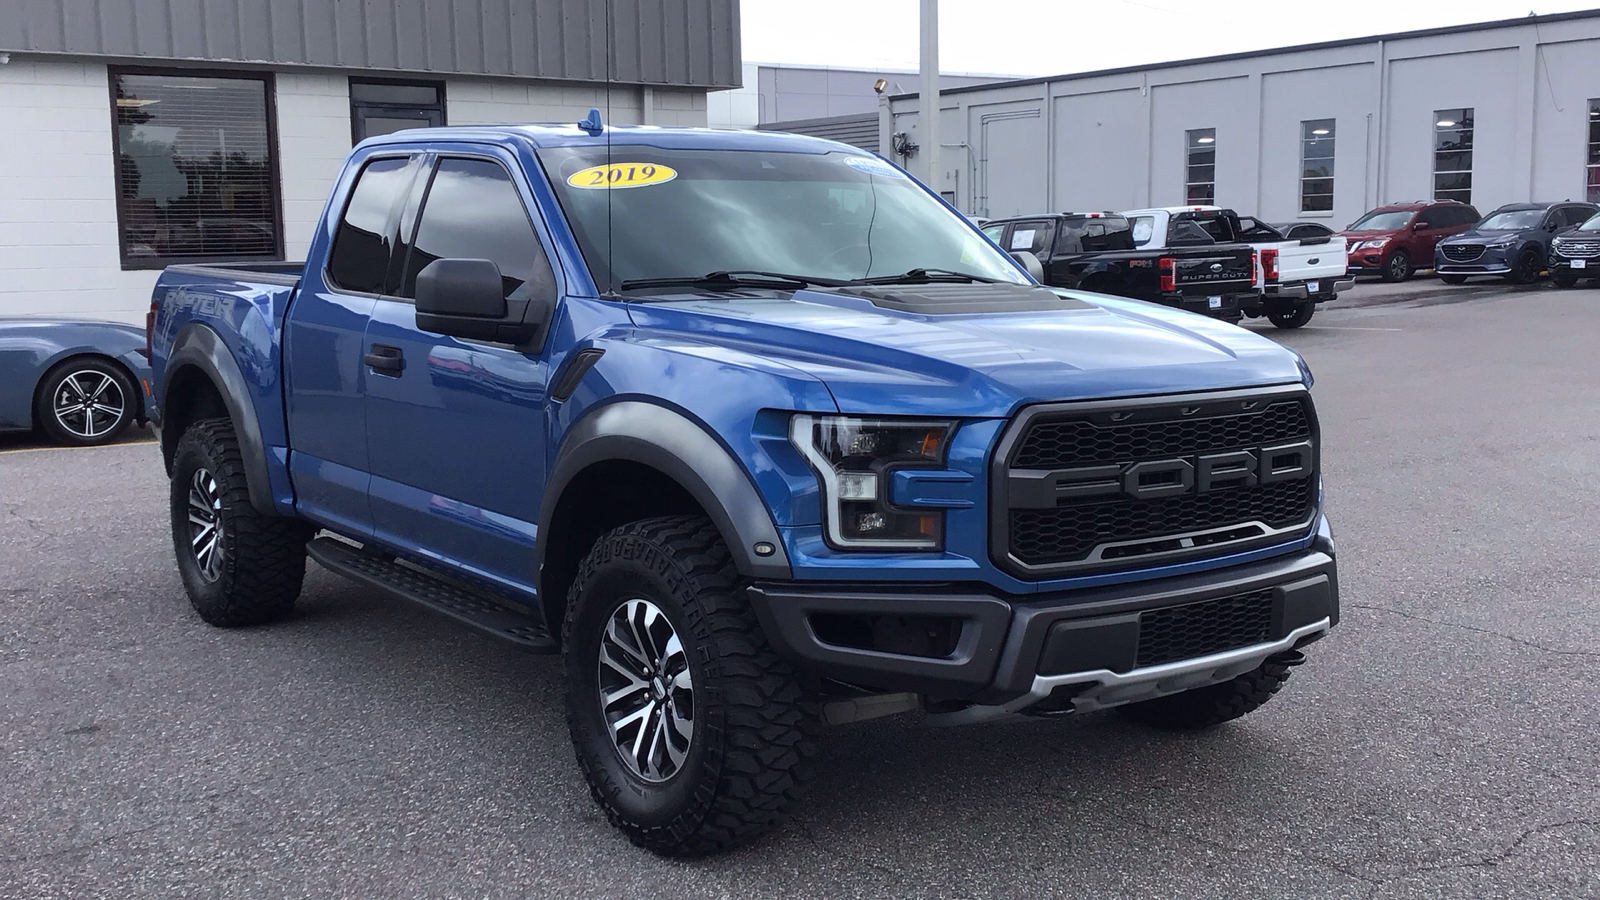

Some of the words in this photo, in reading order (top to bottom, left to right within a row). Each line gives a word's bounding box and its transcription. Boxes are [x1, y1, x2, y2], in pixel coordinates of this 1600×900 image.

[589, 166, 656, 185] 2019
[1181, 273, 1220, 281] SUPER
[1008, 440, 1313, 509] FORD
